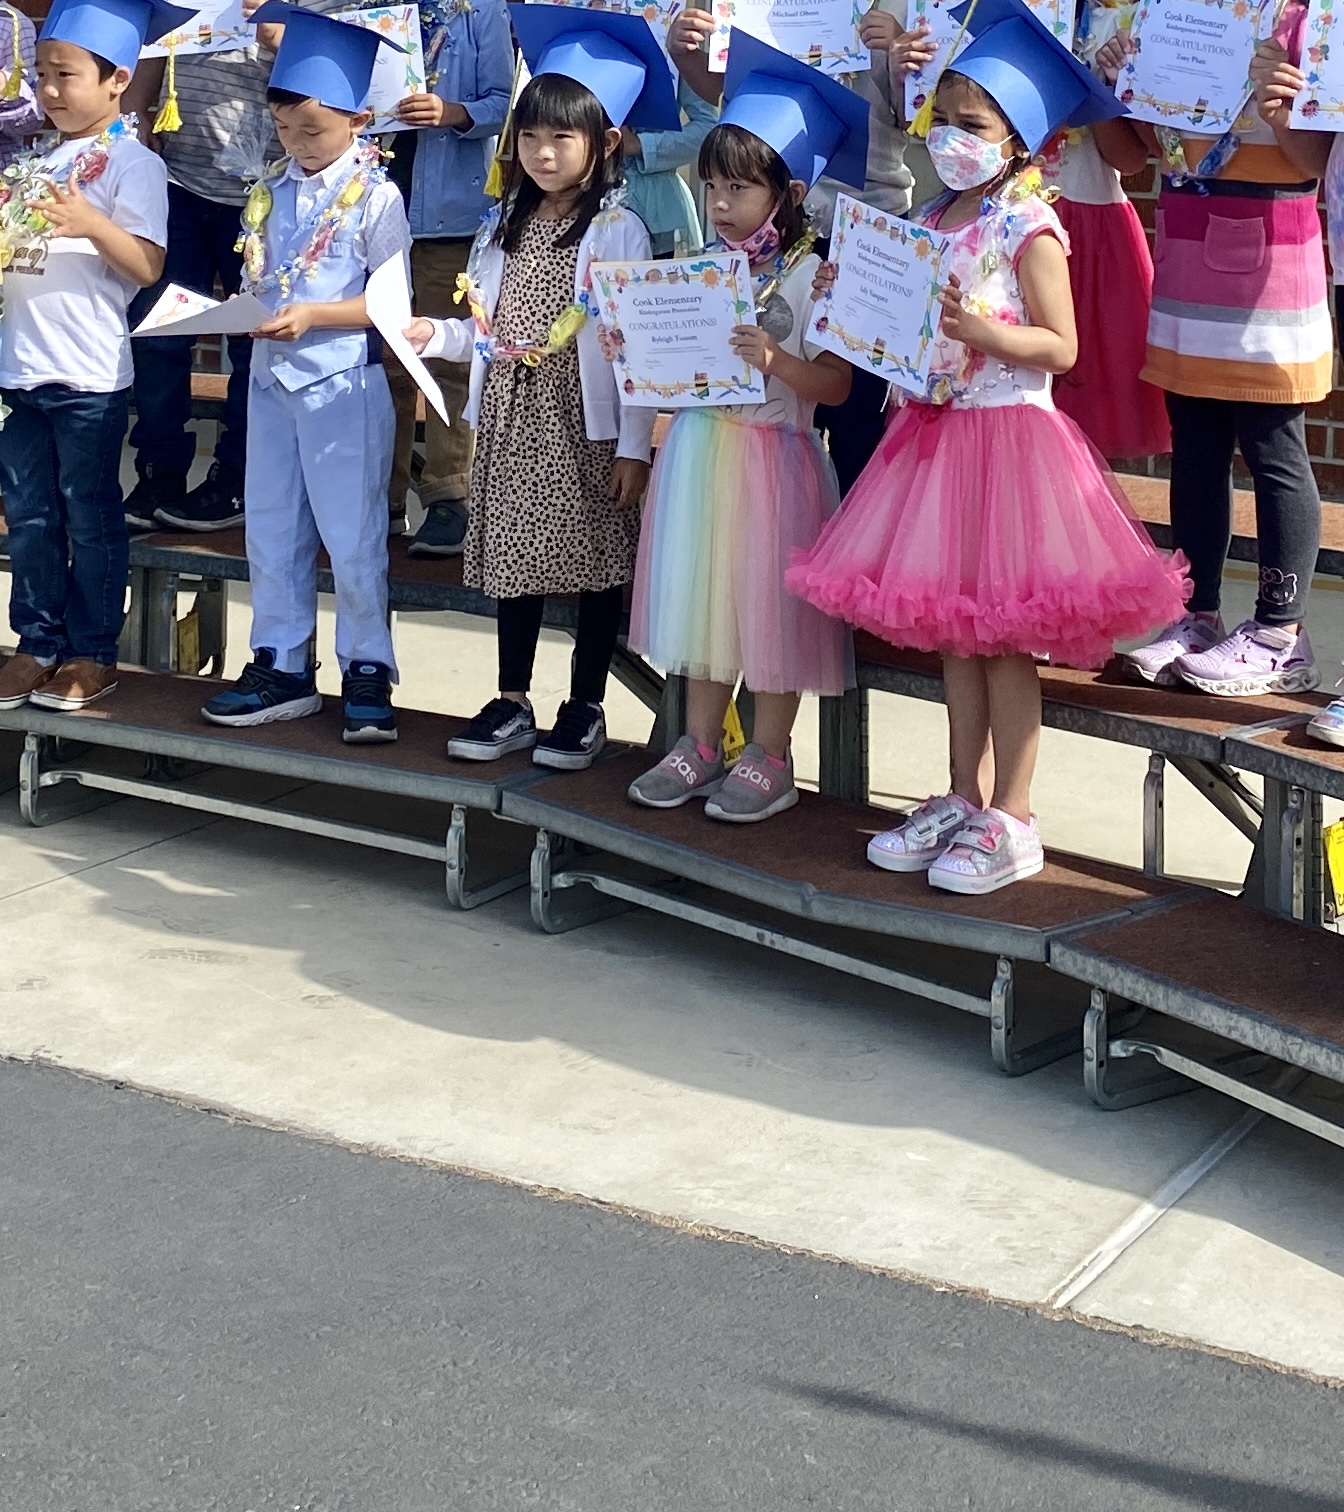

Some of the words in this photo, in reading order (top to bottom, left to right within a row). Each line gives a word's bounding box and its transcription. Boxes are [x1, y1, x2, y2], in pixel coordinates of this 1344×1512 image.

[1164, 10, 1183, 22] Cook
[1185, 14, 1228, 32] Elementary
[856, 238, 871, 254] Cook
[871, 245, 910, 272] Elementary
[633, 297, 654, 307] Cook
[655, 295, 702, 306] Elementary
